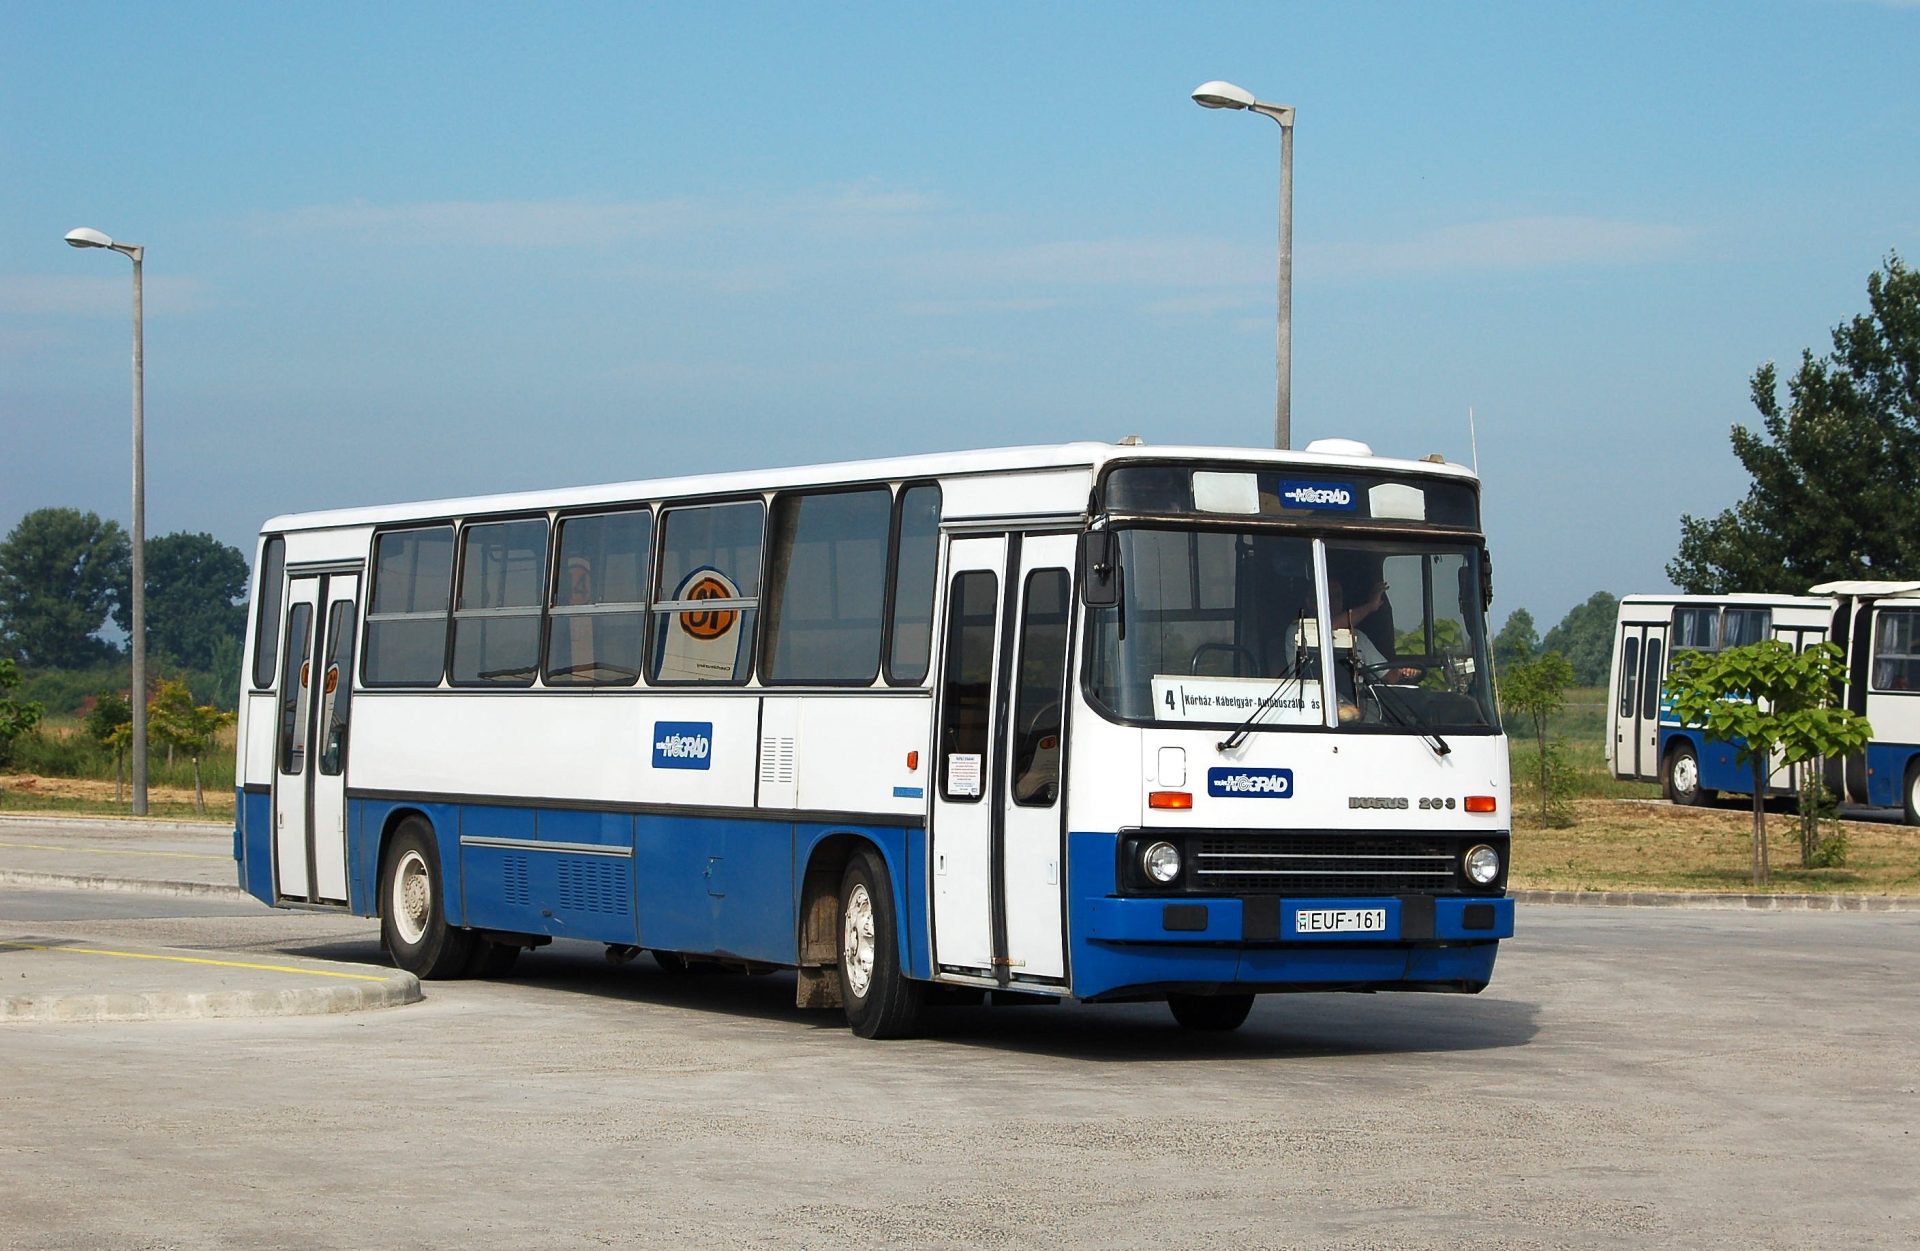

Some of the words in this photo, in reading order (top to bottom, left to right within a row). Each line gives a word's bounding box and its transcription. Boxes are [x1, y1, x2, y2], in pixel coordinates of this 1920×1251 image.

[1165, 690, 1176, 710] 4
[1225, 773, 1288, 792] NÓGRÁD
[1348, 796, 1409, 809] IKARUS
[1311, 911, 1382, 930] EUF-161
